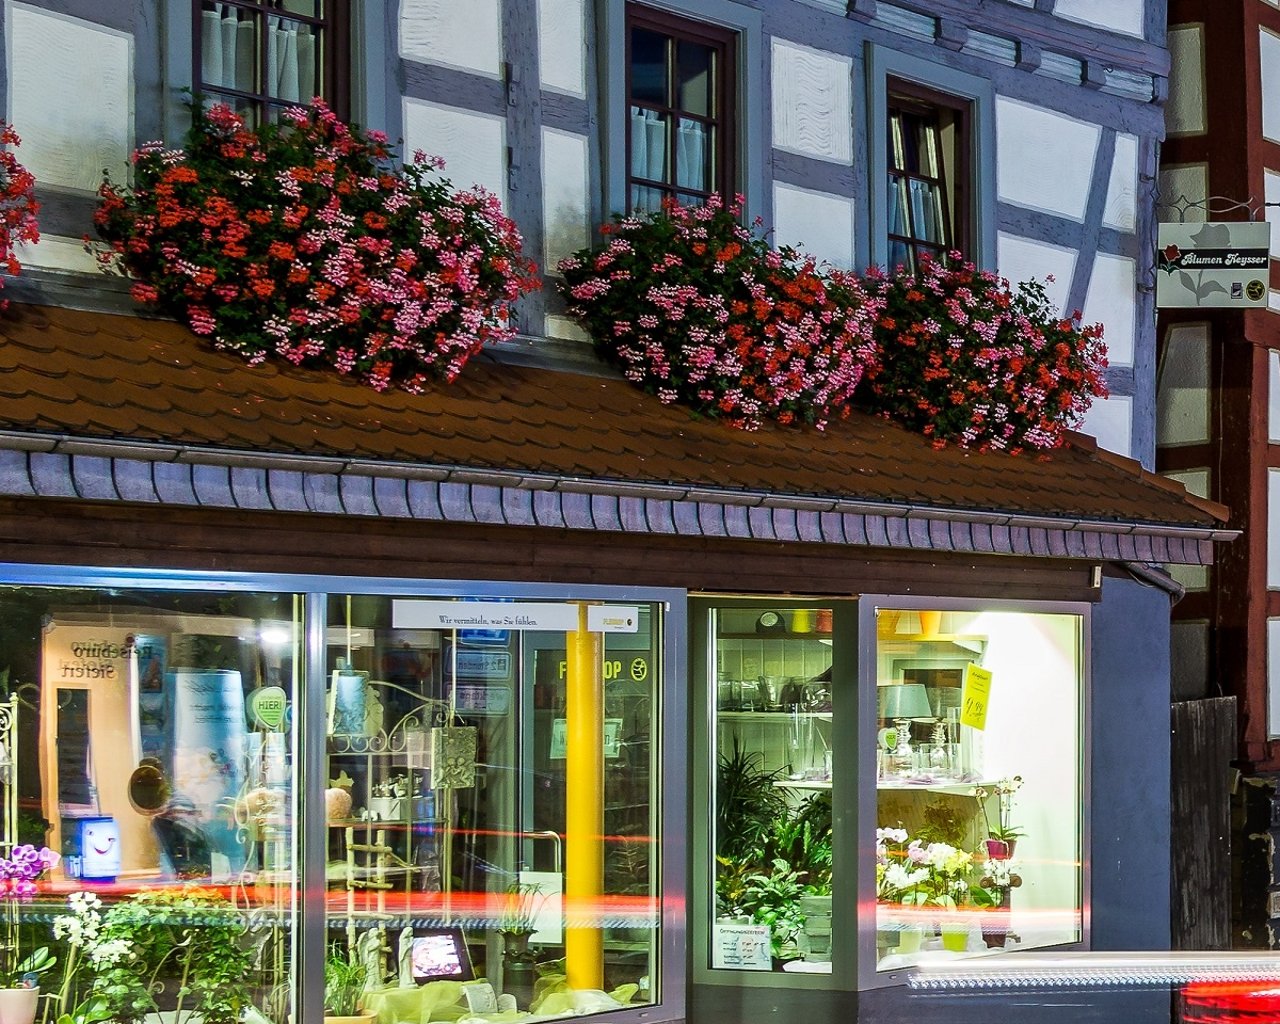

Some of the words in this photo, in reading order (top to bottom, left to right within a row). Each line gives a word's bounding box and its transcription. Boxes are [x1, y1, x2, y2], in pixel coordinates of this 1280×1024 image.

[1181, 253, 1223, 266] Blumen
[439, 614, 452, 623] Wir
[515, 616, 538, 625] fühlen.
